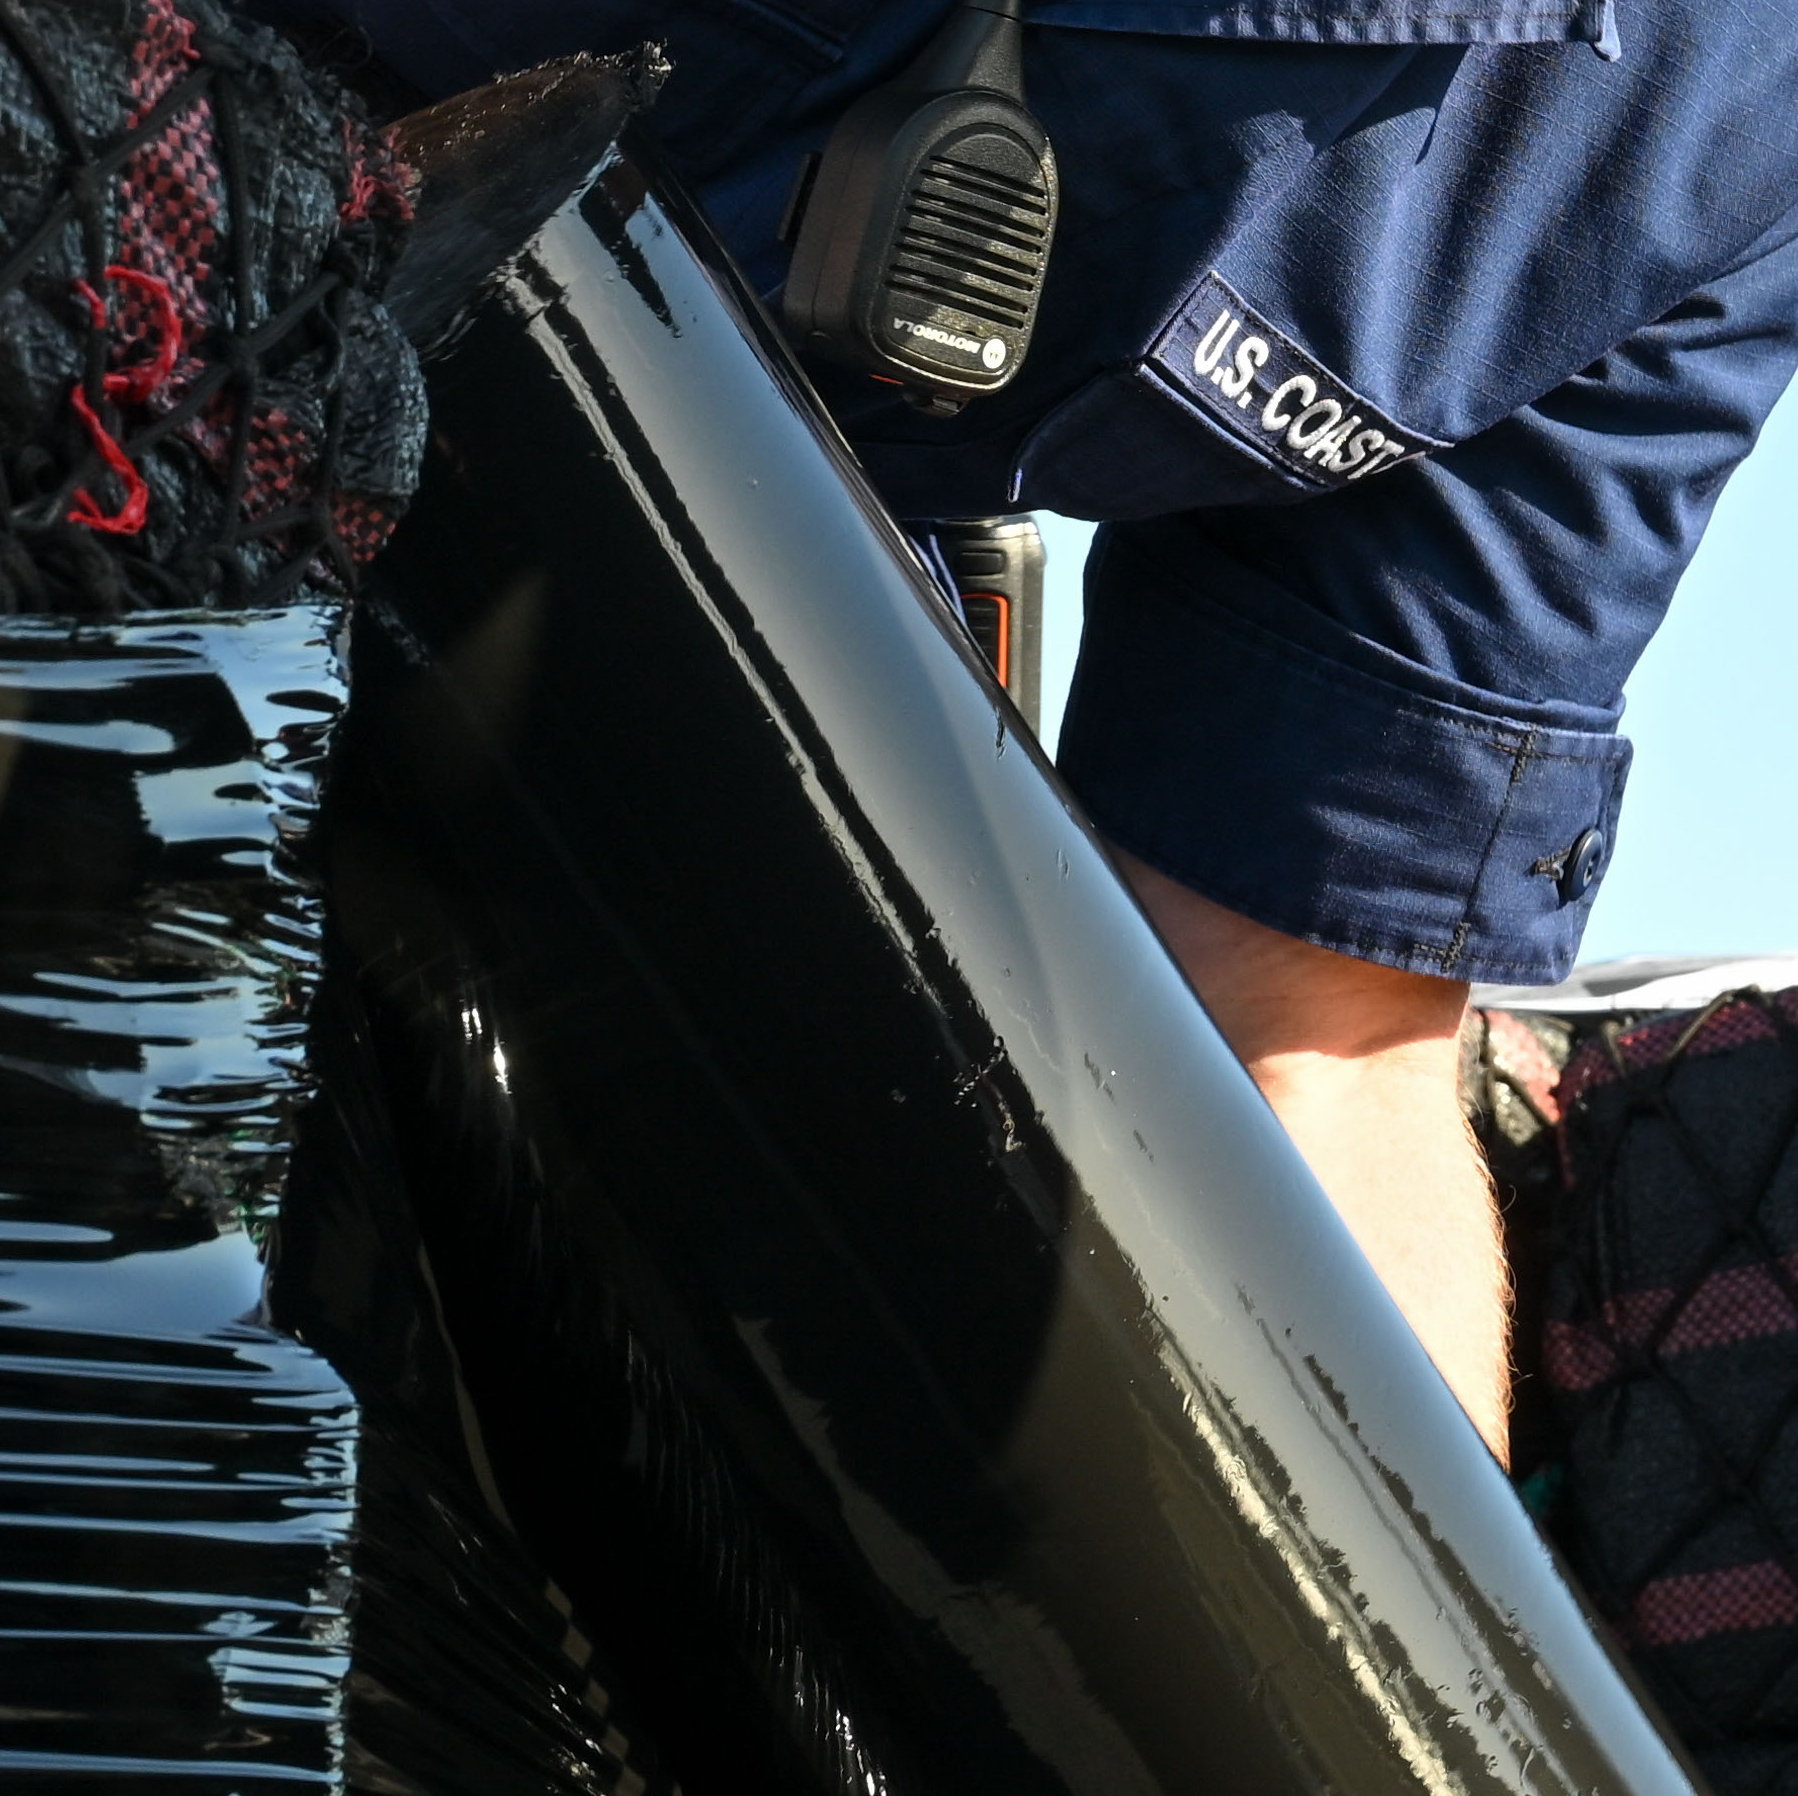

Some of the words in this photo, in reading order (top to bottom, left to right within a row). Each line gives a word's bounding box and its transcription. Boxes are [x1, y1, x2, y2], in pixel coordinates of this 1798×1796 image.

[893, 317, 981, 354] MOTOROLA
[1193, 309, 1270, 409] U.S.
[1261, 374, 1405, 480] COAST
